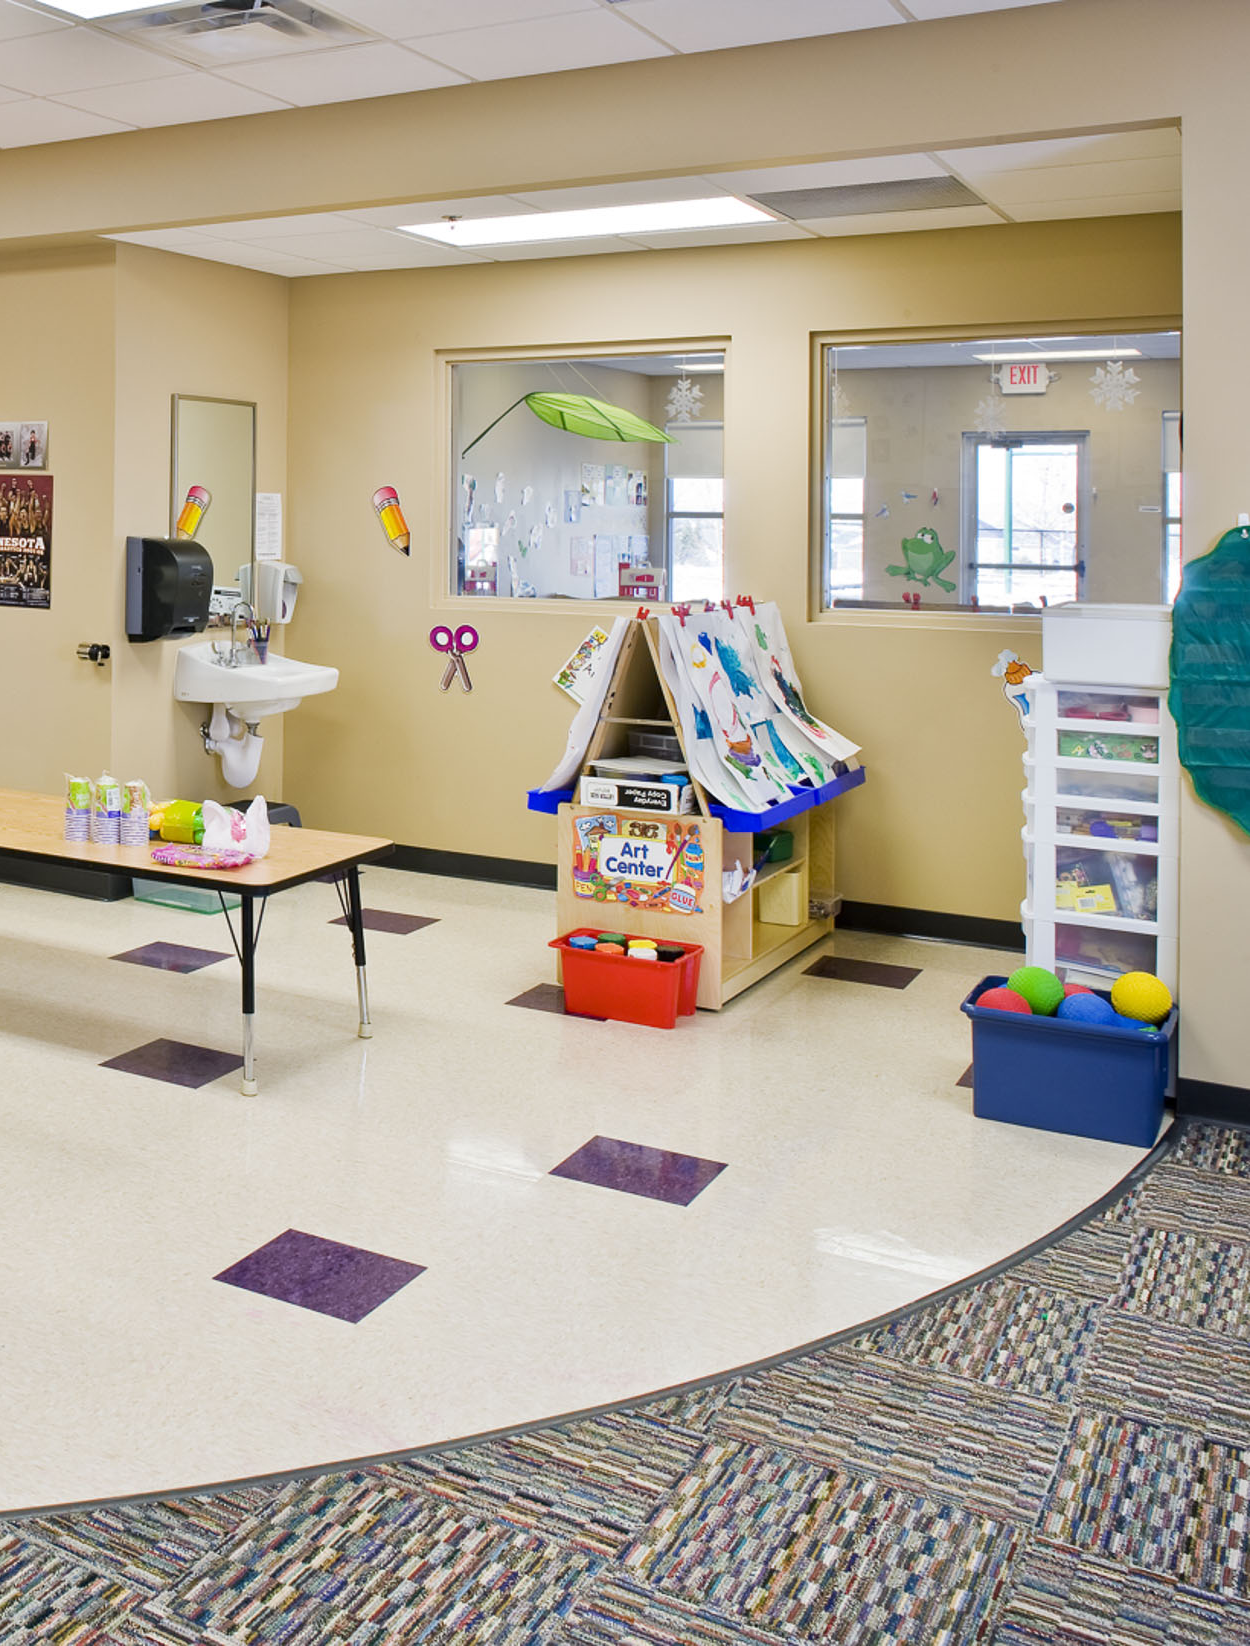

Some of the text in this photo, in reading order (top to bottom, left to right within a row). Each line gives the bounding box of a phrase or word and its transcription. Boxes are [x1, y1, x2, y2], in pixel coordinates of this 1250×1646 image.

[1010, 365, 1039, 385] EXIT
[624, 788, 667, 800] Copy Paper
[633, 796, 667, 808] Everyday
[620, 841, 650, 860] Art
[605, 856, 664, 879] Center
[671, 892, 696, 907] GLUE
